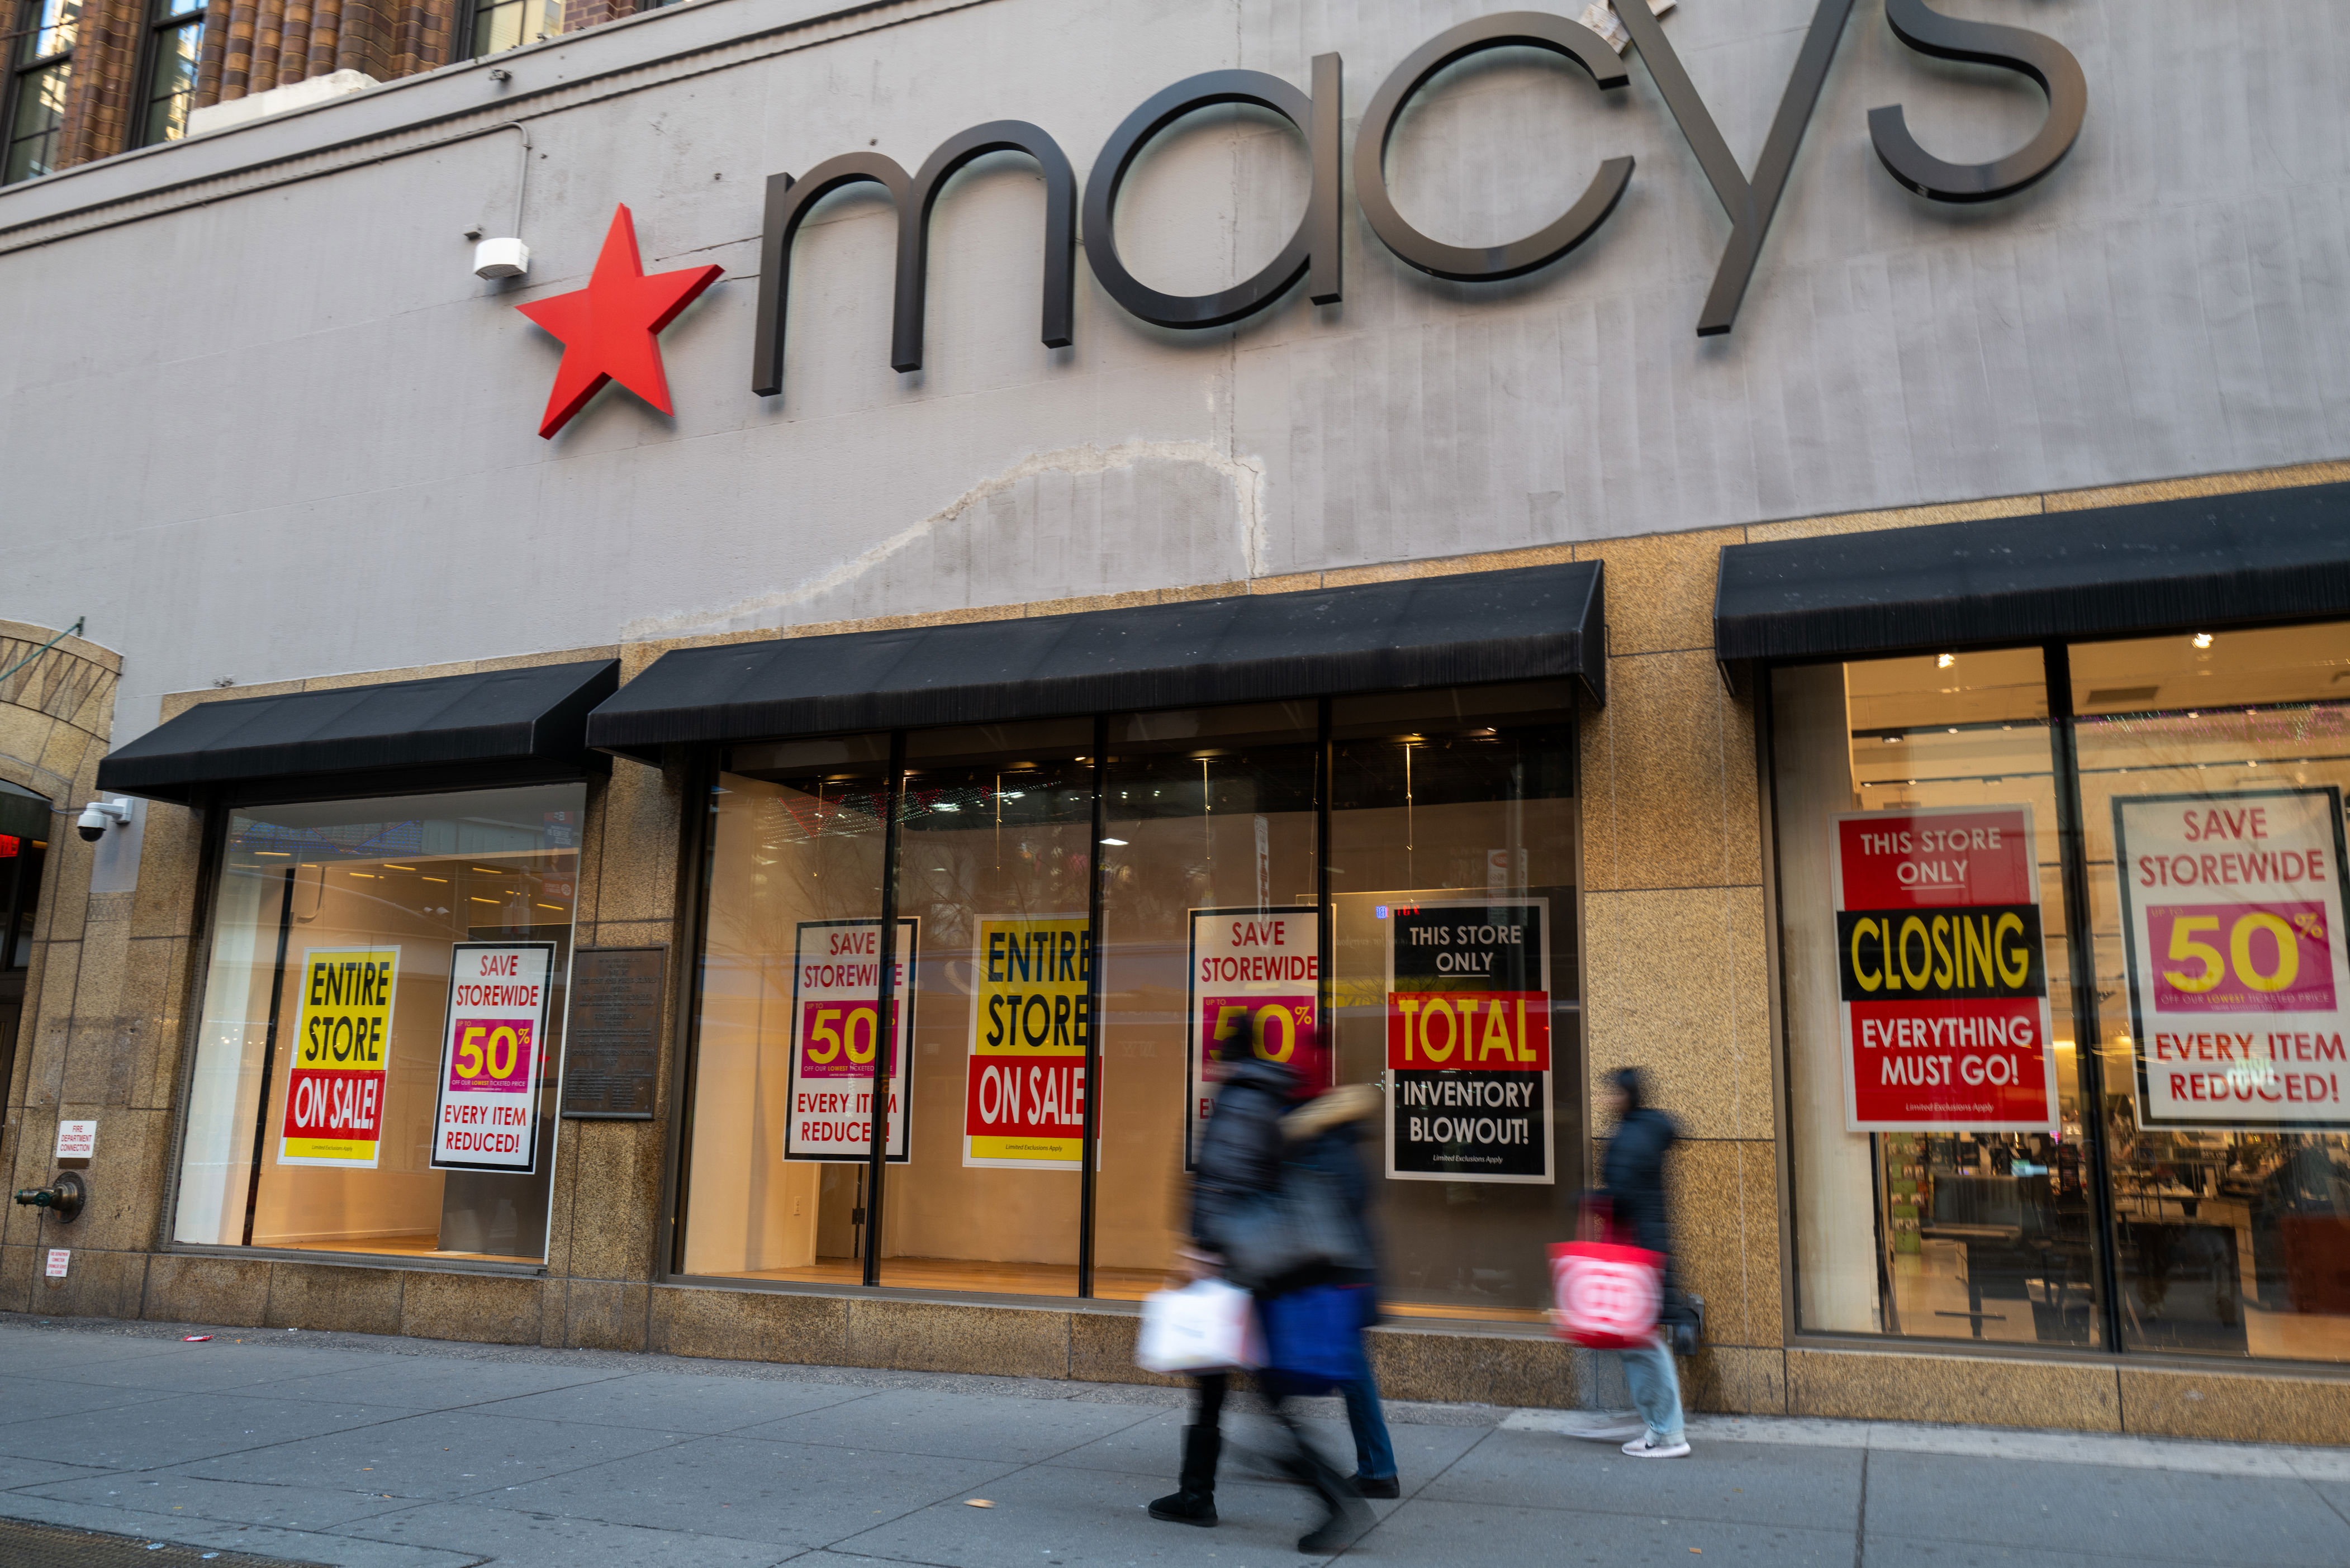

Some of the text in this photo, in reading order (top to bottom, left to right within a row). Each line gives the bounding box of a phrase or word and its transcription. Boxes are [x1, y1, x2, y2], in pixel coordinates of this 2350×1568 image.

[2183, 807, 2269, 842] SAVE
[1860, 827, 2002, 856] THIS STORE
[1897, 859, 1968, 884] ONLY
[2139, 849, 2326, 887] STOREWIDE
[830, 932, 875, 956] SAVE
[1231, 921, 1285, 947] SAVE
[1409, 926, 1450, 945] THIS
[1457, 925, 1522, 944] STORE
[480, 955, 519, 977] SAVE
[988, 930, 1089, 982] ENTIRE
[1436, 952, 1494, 971] ONLY
[1851, 912, 2029, 992] CLOSING
[2162, 911, 2323, 994] 50%
[804, 963, 903, 989] STOREWIE
[1201, 956, 1318, 982] STOREWIDE
[310, 962, 390, 1006] ENTIRE
[456, 985, 539, 1006] STOREWIDE
[986, 994, 1087, 1047] STORE
[1399, 998, 1536, 1062] TOTAL
[1862, 1016, 2034, 1048] EVERYTHING
[305, 1016, 382, 1062] STORE
[807, 1008, 895, 1064] 50
[2156, 1032, 2346, 1062] EVERY ITEM
[455, 1026, 530, 1079] 50%
[1882, 1054, 2020, 1086] MUST GO!
[979, 1065, 1020, 1124] ON
[1404, 1081, 1534, 1108] INVENTORY
[2170, 1073, 2340, 1103] REDUCED!
[295, 1077, 378, 1130] ON SALE!
[445, 1104, 526, 1127] EVERY ITEM
[797, 1094, 898, 1114] EVERY ITM
[1906, 1102, 1995, 1113] Limited Exclusions Apply
[446, 1131, 519, 1153] REDUCED!
[801, 1122, 890, 1143] REDUCE!
[1410, 1117, 1529, 1144] BLOWOUT!
[1485, 1156, 1503, 1164] Apply
